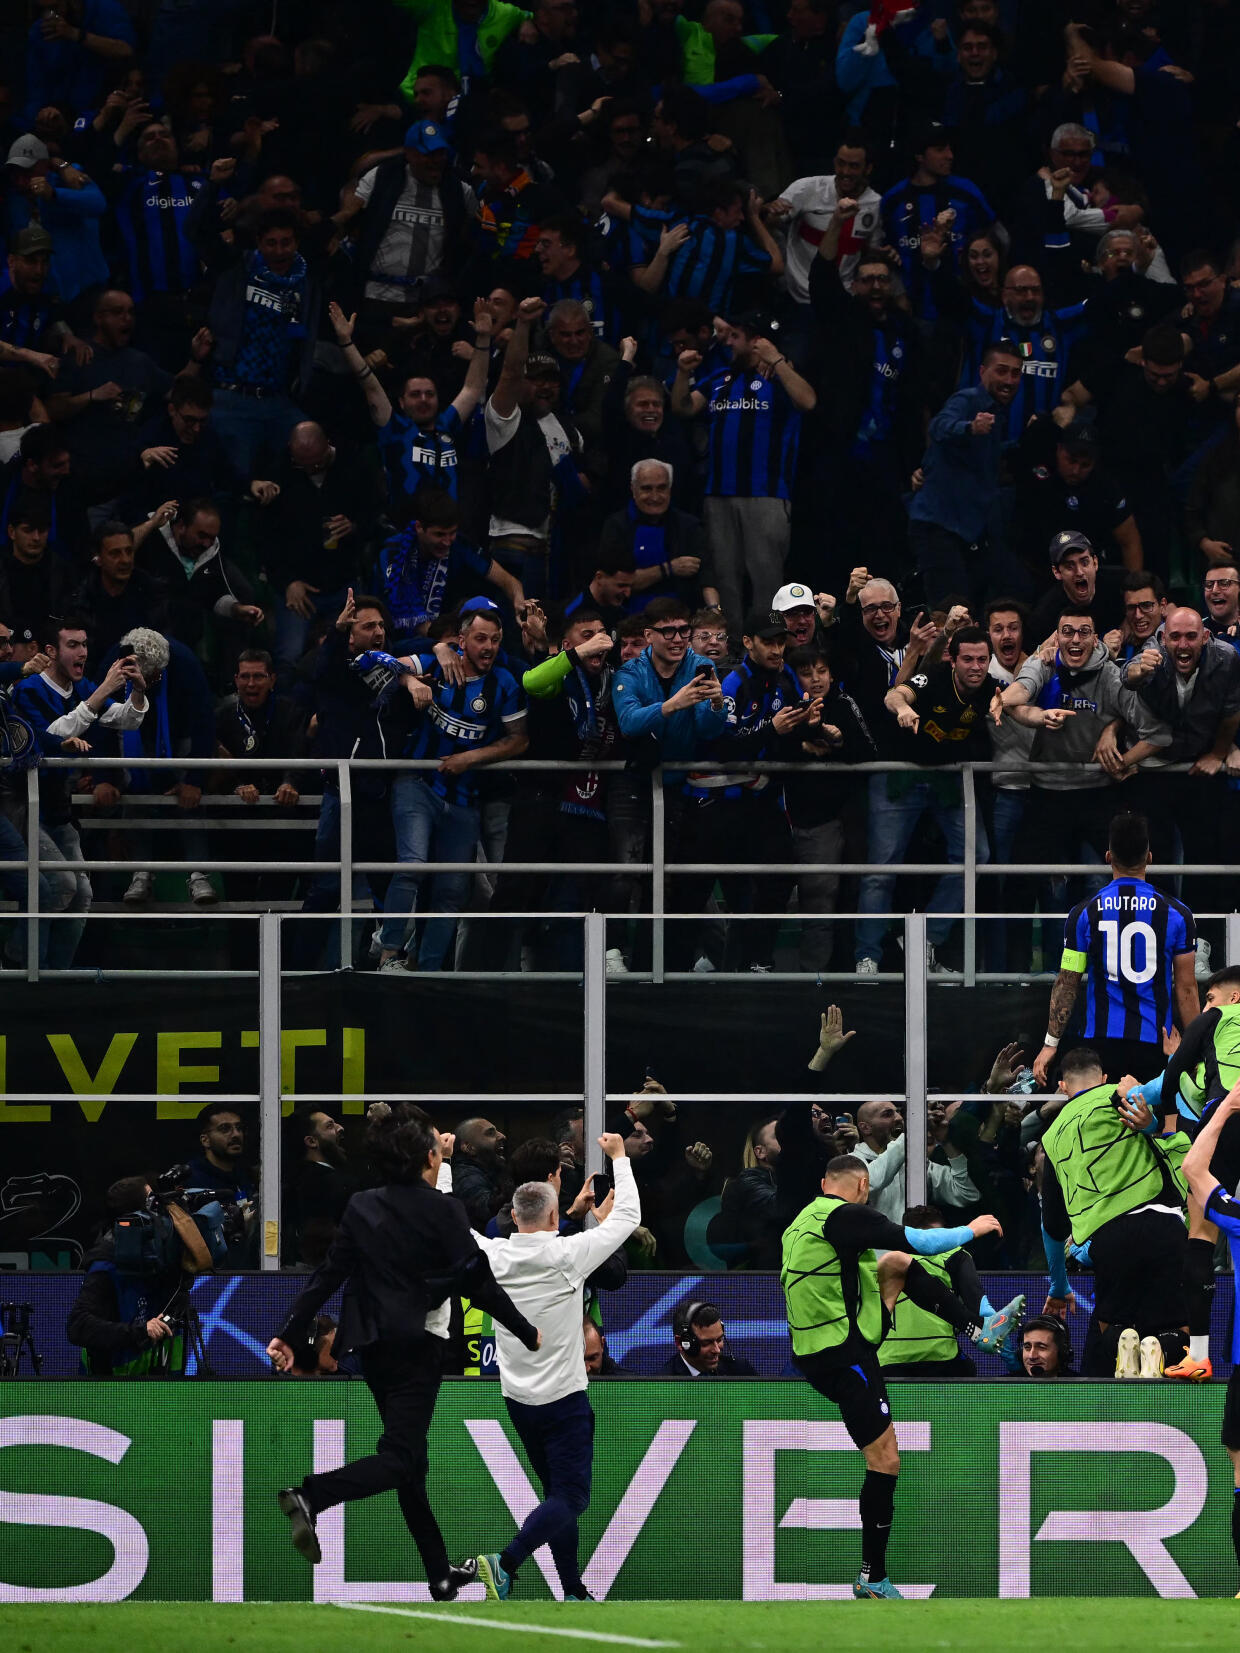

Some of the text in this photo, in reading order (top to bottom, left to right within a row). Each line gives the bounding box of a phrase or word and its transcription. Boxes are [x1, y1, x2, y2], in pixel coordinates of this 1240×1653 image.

[1097, 896, 1157, 911] LAUTARO
[1098, 919, 1158, 984] 10
[0, 1415, 1208, 1603] SILVER
